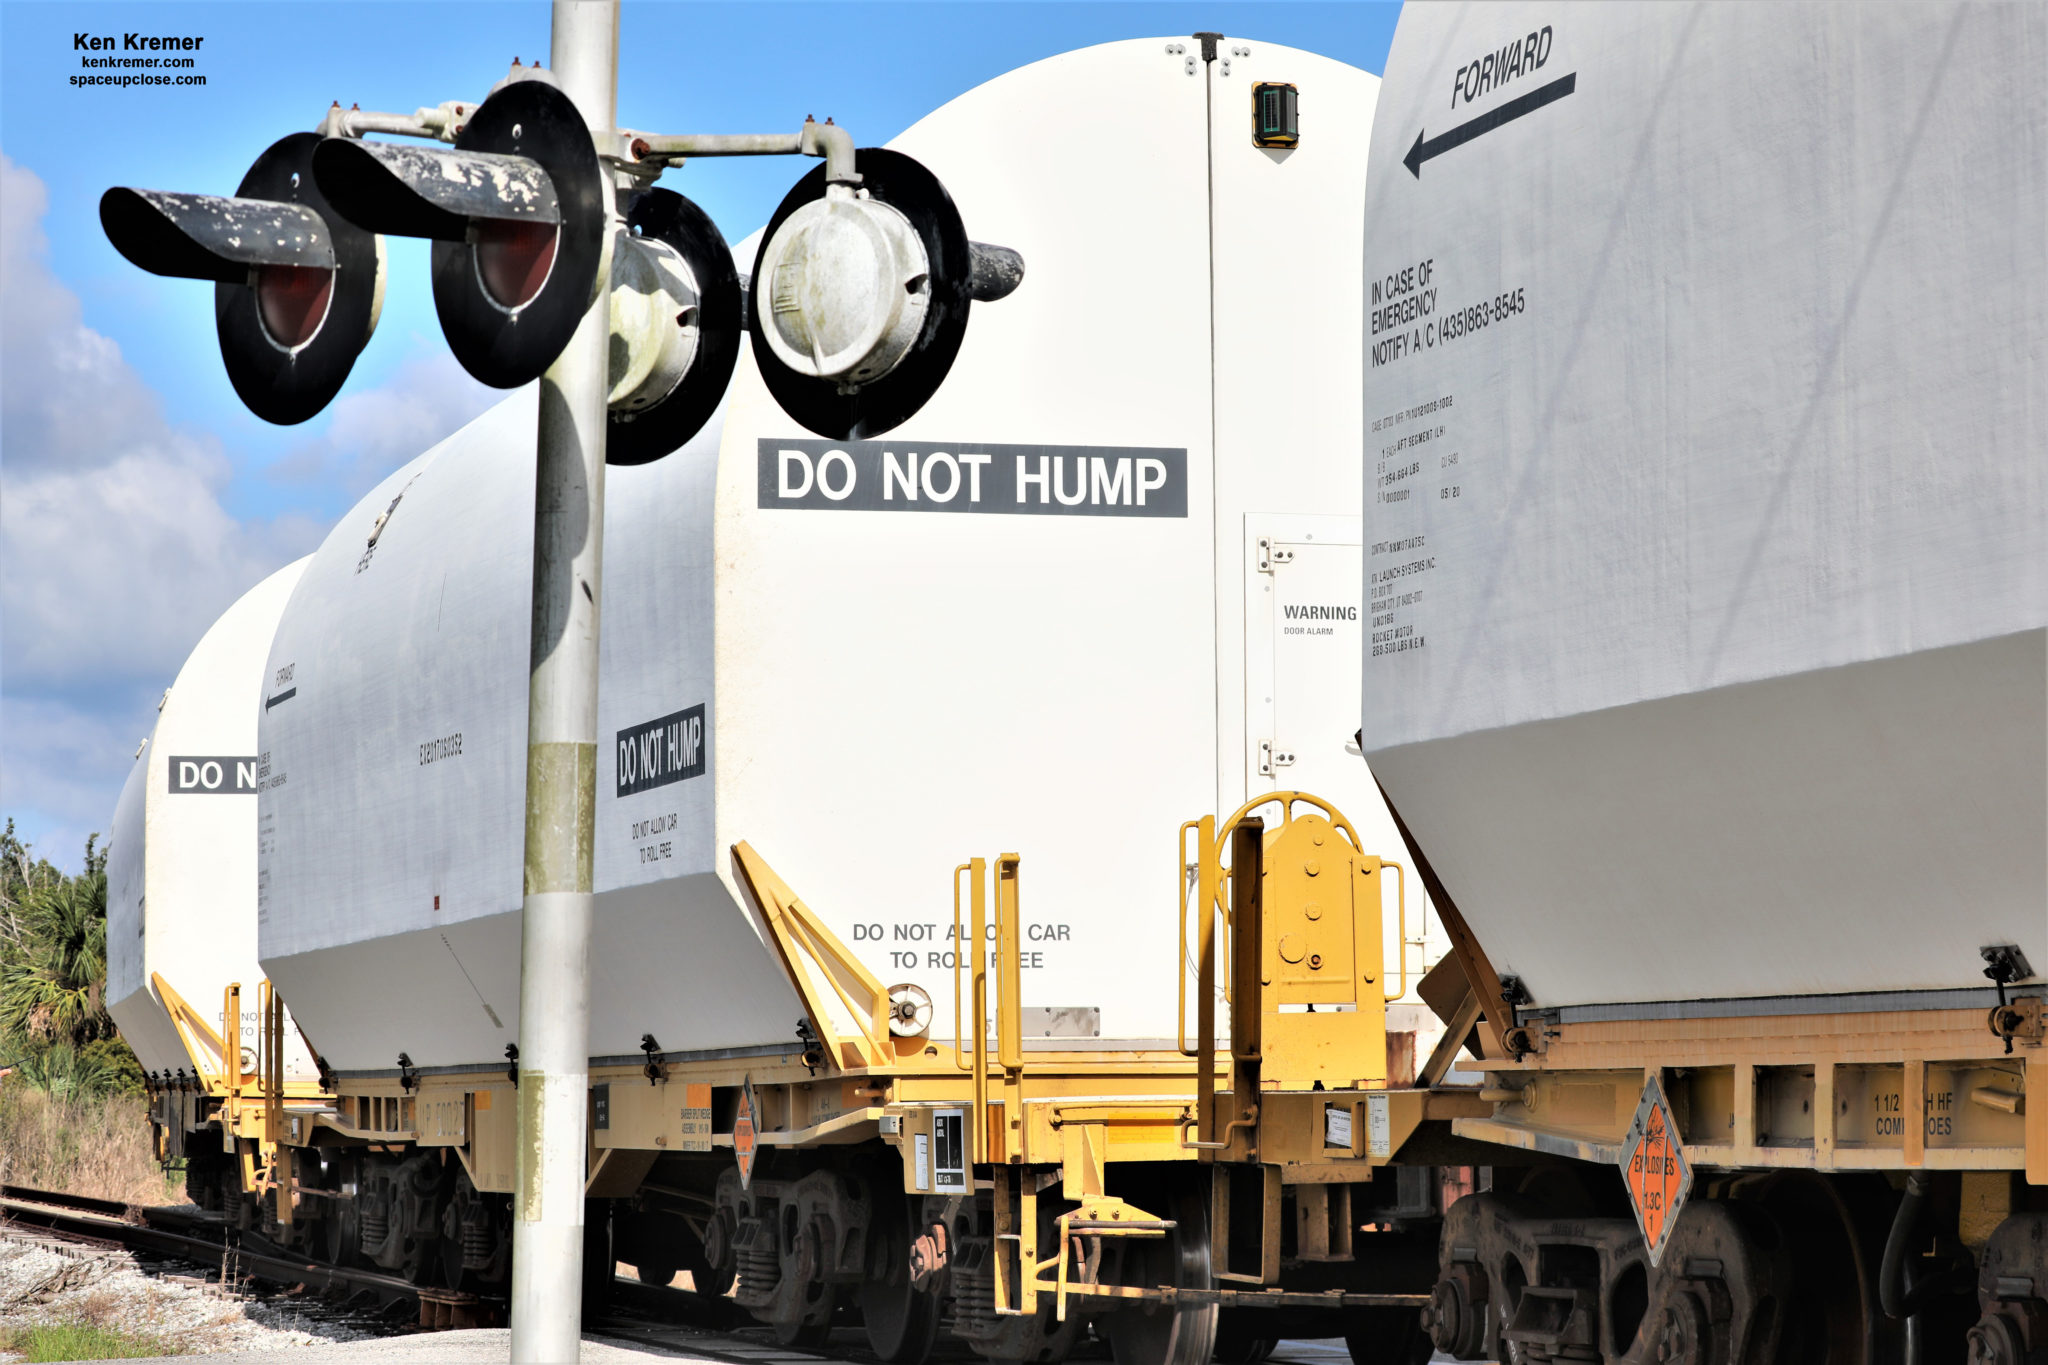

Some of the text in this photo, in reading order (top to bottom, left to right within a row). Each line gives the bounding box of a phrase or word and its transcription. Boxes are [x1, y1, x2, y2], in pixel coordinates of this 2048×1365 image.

[1451, 25, 1553, 110] FORWARD
[1372, 259, 1433, 306] IN CASE OF
[1371, 288, 1437, 335] EMERGENCY
[1372, 287, 1525, 368] NOTIFY A/C (435)863-8545
[1397, 438, 1407, 451] AFT
[1409, 429, 1433, 447] SEGMENT
[778, 449, 1167, 506] DO NOT HUMP
[1380, 567, 1400, 582] LAUNCH
[1402, 559, 1424, 577] SYSTEMS
[1283, 605, 1357, 620] WARNING
[1284, 627, 1333, 635] DOOR ALARM
[1372, 625, 1413, 644] ROCKET MOTOR
[620, 715, 701, 786] DO NOT HUMP
[178, 761, 223, 789] DO
[632, 813, 678, 840] DO NOT ALLOW CAR
[647, 844, 658, 862] ROLL
[659, 841, 672, 860] FREE
[853, 923, 884, 941] DO
[894, 924, 936, 941] NOT
[1028, 924, 1071, 941] CAR
[890, 951, 918, 969] TO
[928, 952, 976, 969] ROL
[1874, 1094, 1880, 1112] 1
[1884, 1094, 1899, 1112] 1/2
[1938, 1092, 1953, 1110] HF
[1876, 1117, 1905, 1135] COM
[1644, 1191, 1661, 1211] 1.3C
[1649, 1215, 1653, 1232] 1
